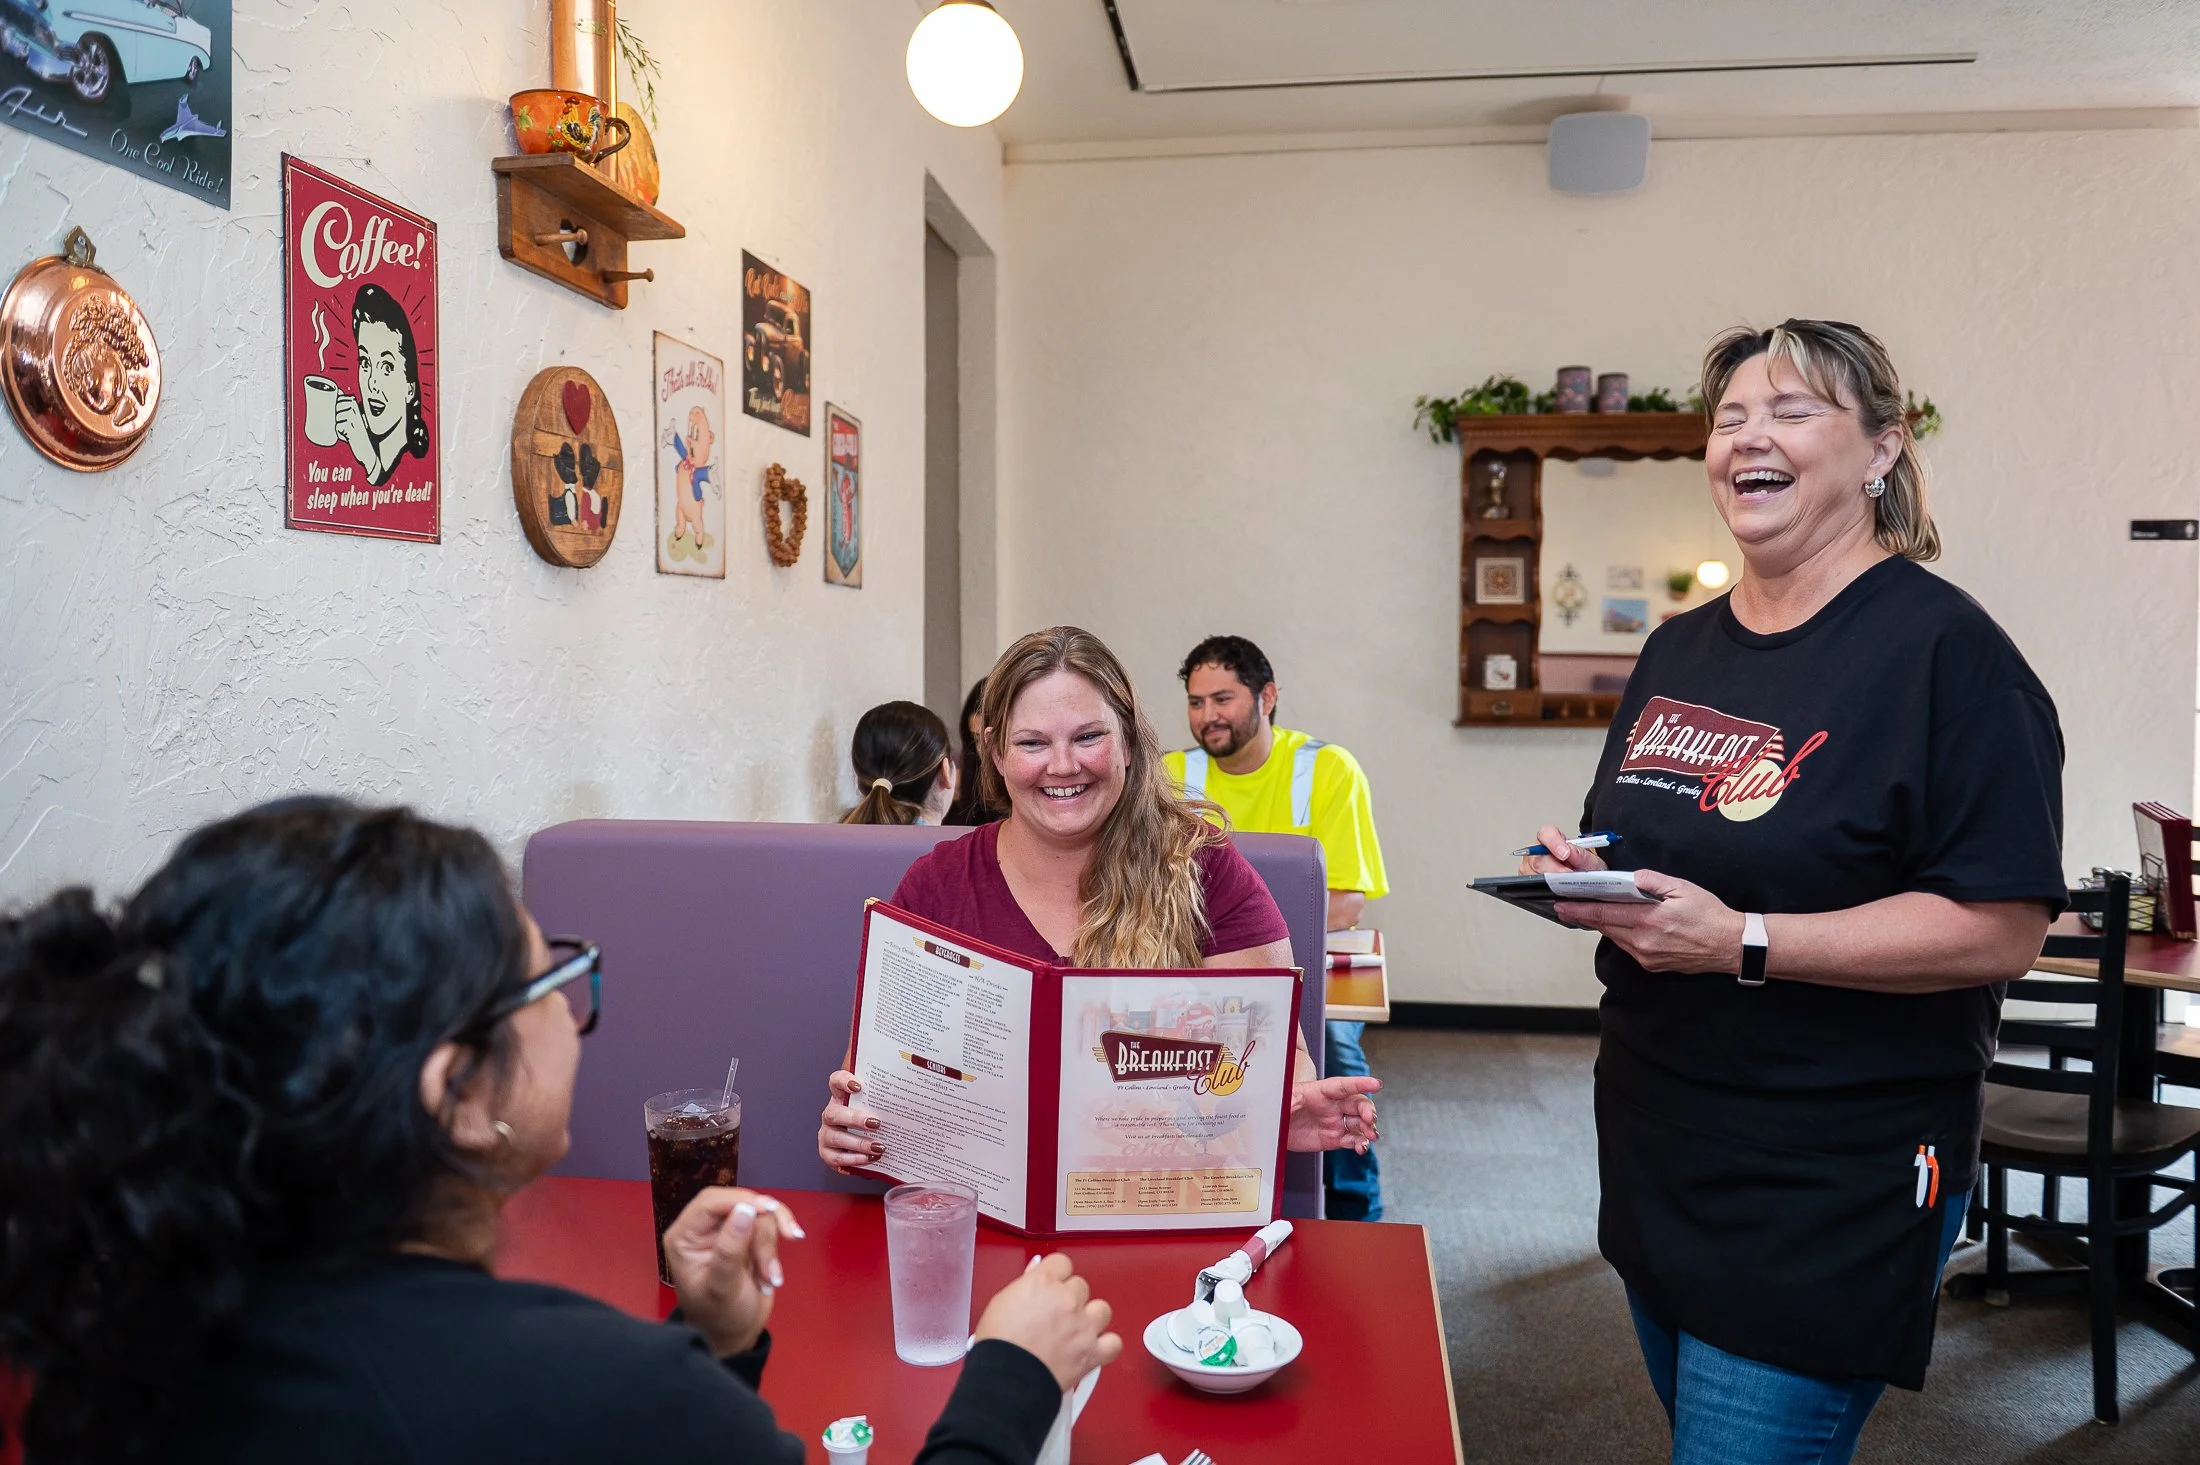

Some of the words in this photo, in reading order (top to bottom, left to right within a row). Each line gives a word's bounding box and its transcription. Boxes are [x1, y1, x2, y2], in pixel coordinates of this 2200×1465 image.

[110, 128, 140, 160] One
[144, 142, 176, 174] Cool
[181, 156, 224, 193] Ride!
[300, 200, 426, 289] Coffee!
[308, 460, 329, 483] You
[332, 466, 352, 482] can
[306, 487, 338, 515] sleep
[341, 485, 369, 509] when
[372, 484, 403, 511] you're
[405, 481, 432, 502] dead!
[1667, 713, 1682, 724] THE
[1628, 713, 1760, 769] BREAKFAST
[1699, 730, 1829, 812] Club
[1622, 774, 1641, 785] Collins
[1643, 777, 1677, 790] Loveland
[1676, 784, 1702, 800] Greeley
[1130, 1041, 1141, 1049] THE
[1115, 1041, 1214, 1075] BREAKFAST
[1186, 1040, 1256, 1096] Club
[924, 1077, 948, 1091] Breakfast
[928, 1128, 945, 1139] Lunch
